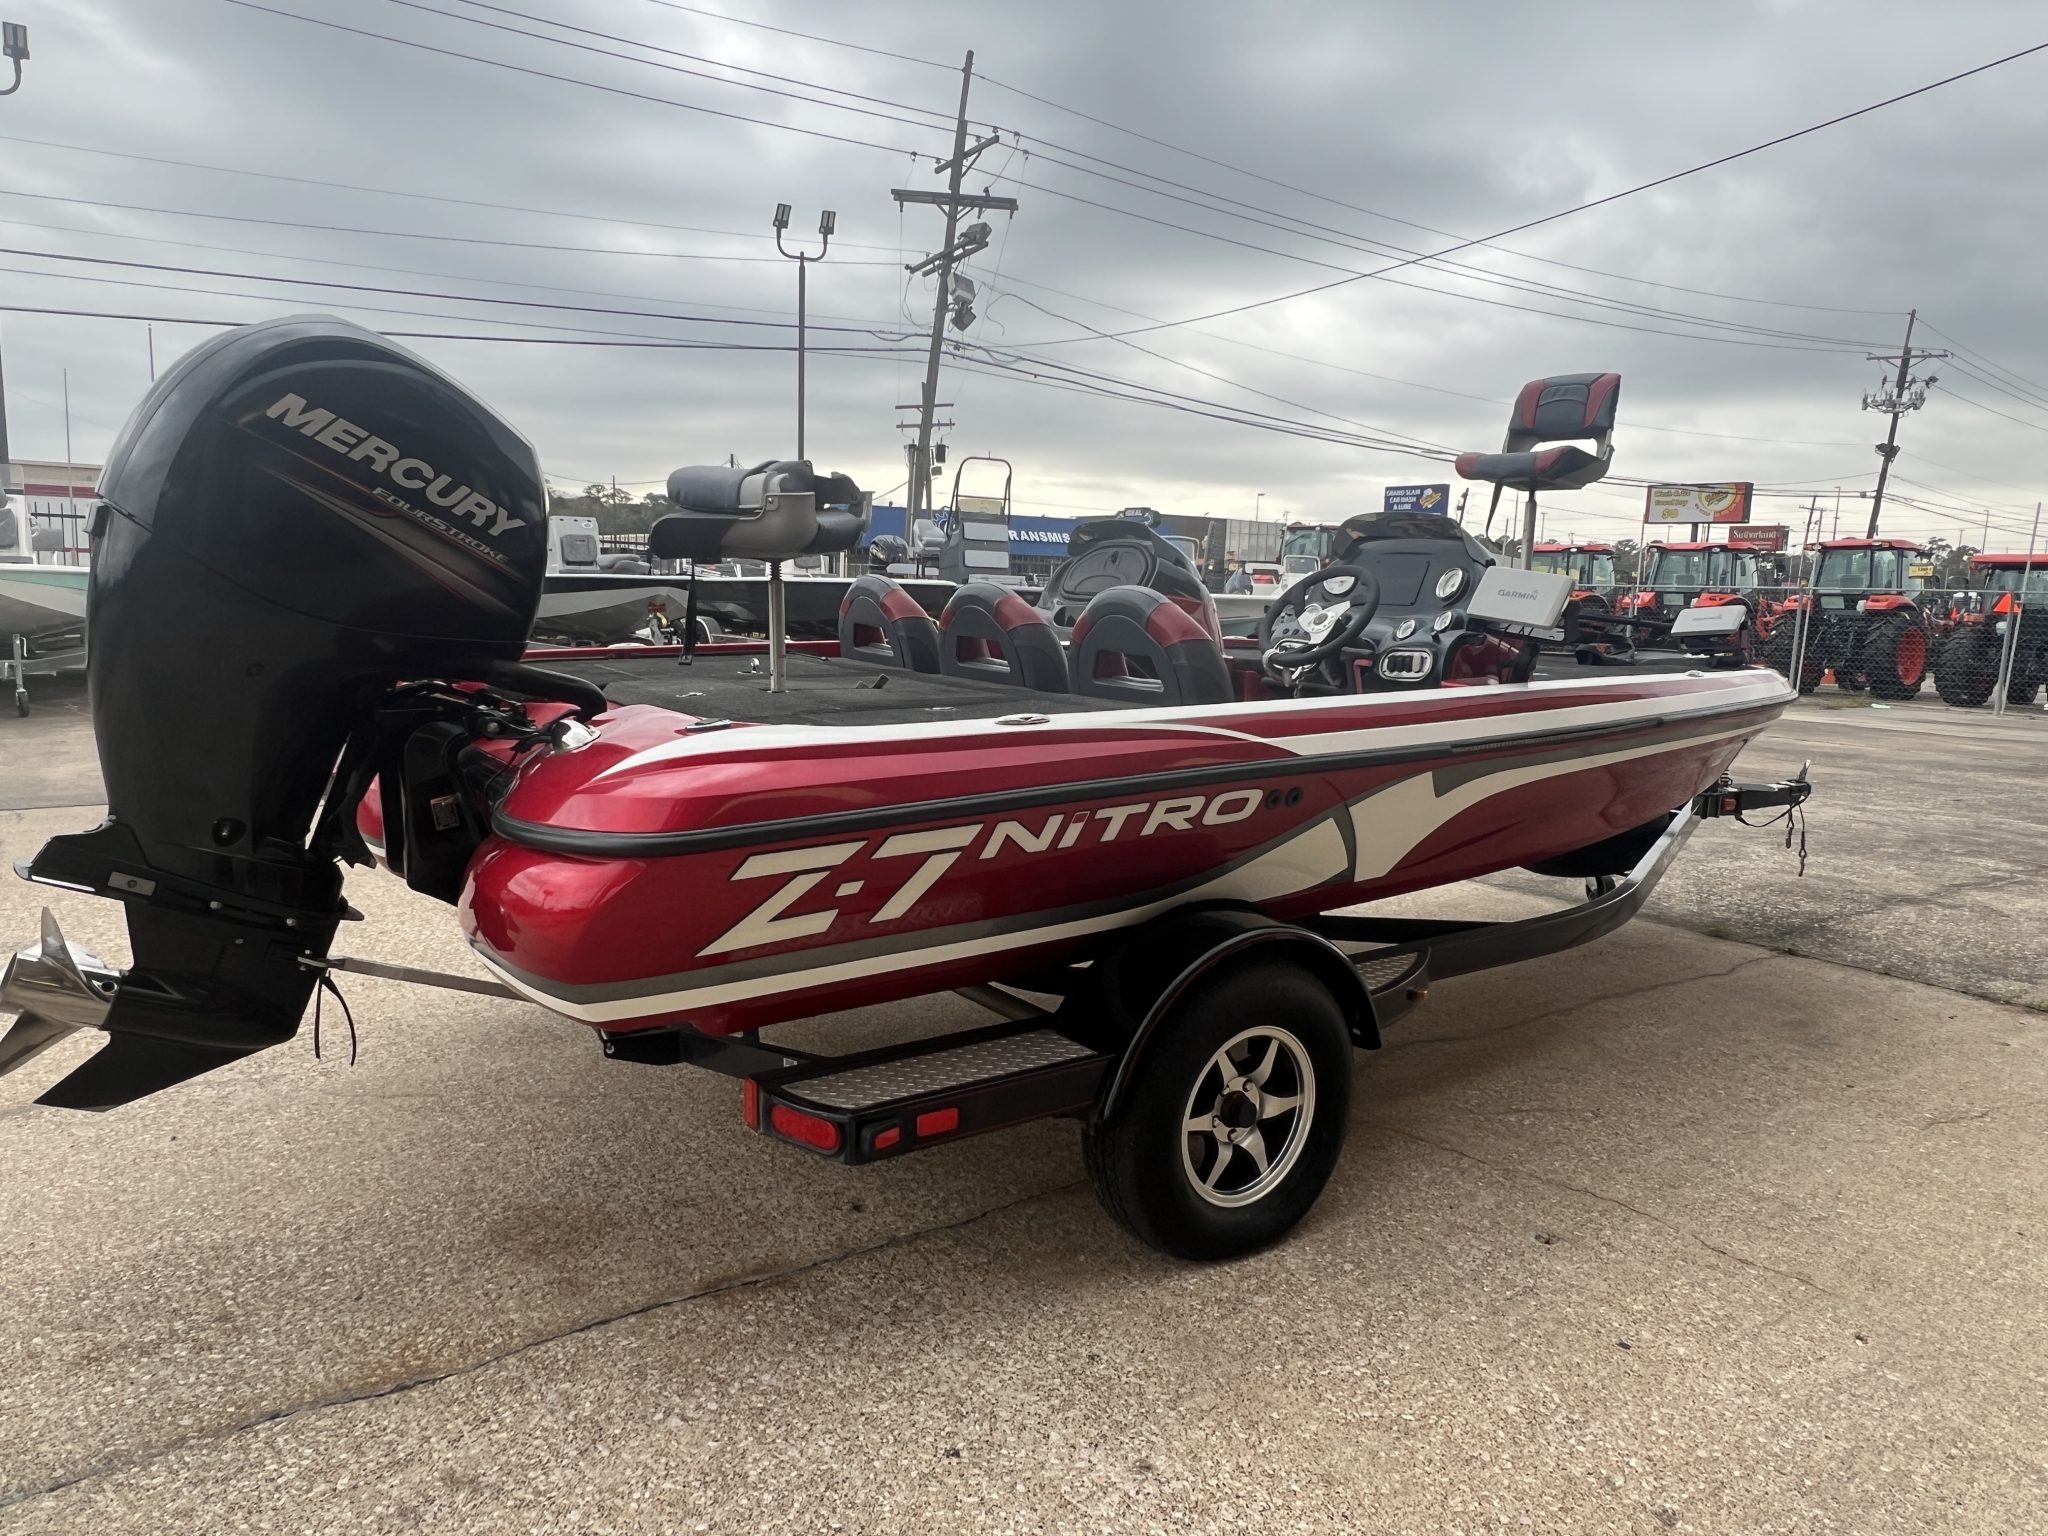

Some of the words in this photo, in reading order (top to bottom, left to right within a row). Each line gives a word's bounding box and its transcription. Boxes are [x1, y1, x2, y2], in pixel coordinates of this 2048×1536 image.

[266, 392, 527, 537] MERCURY
[372, 487, 510, 563] FOURSTROKE
[1497, 588, 1538, 601] GARMIN
